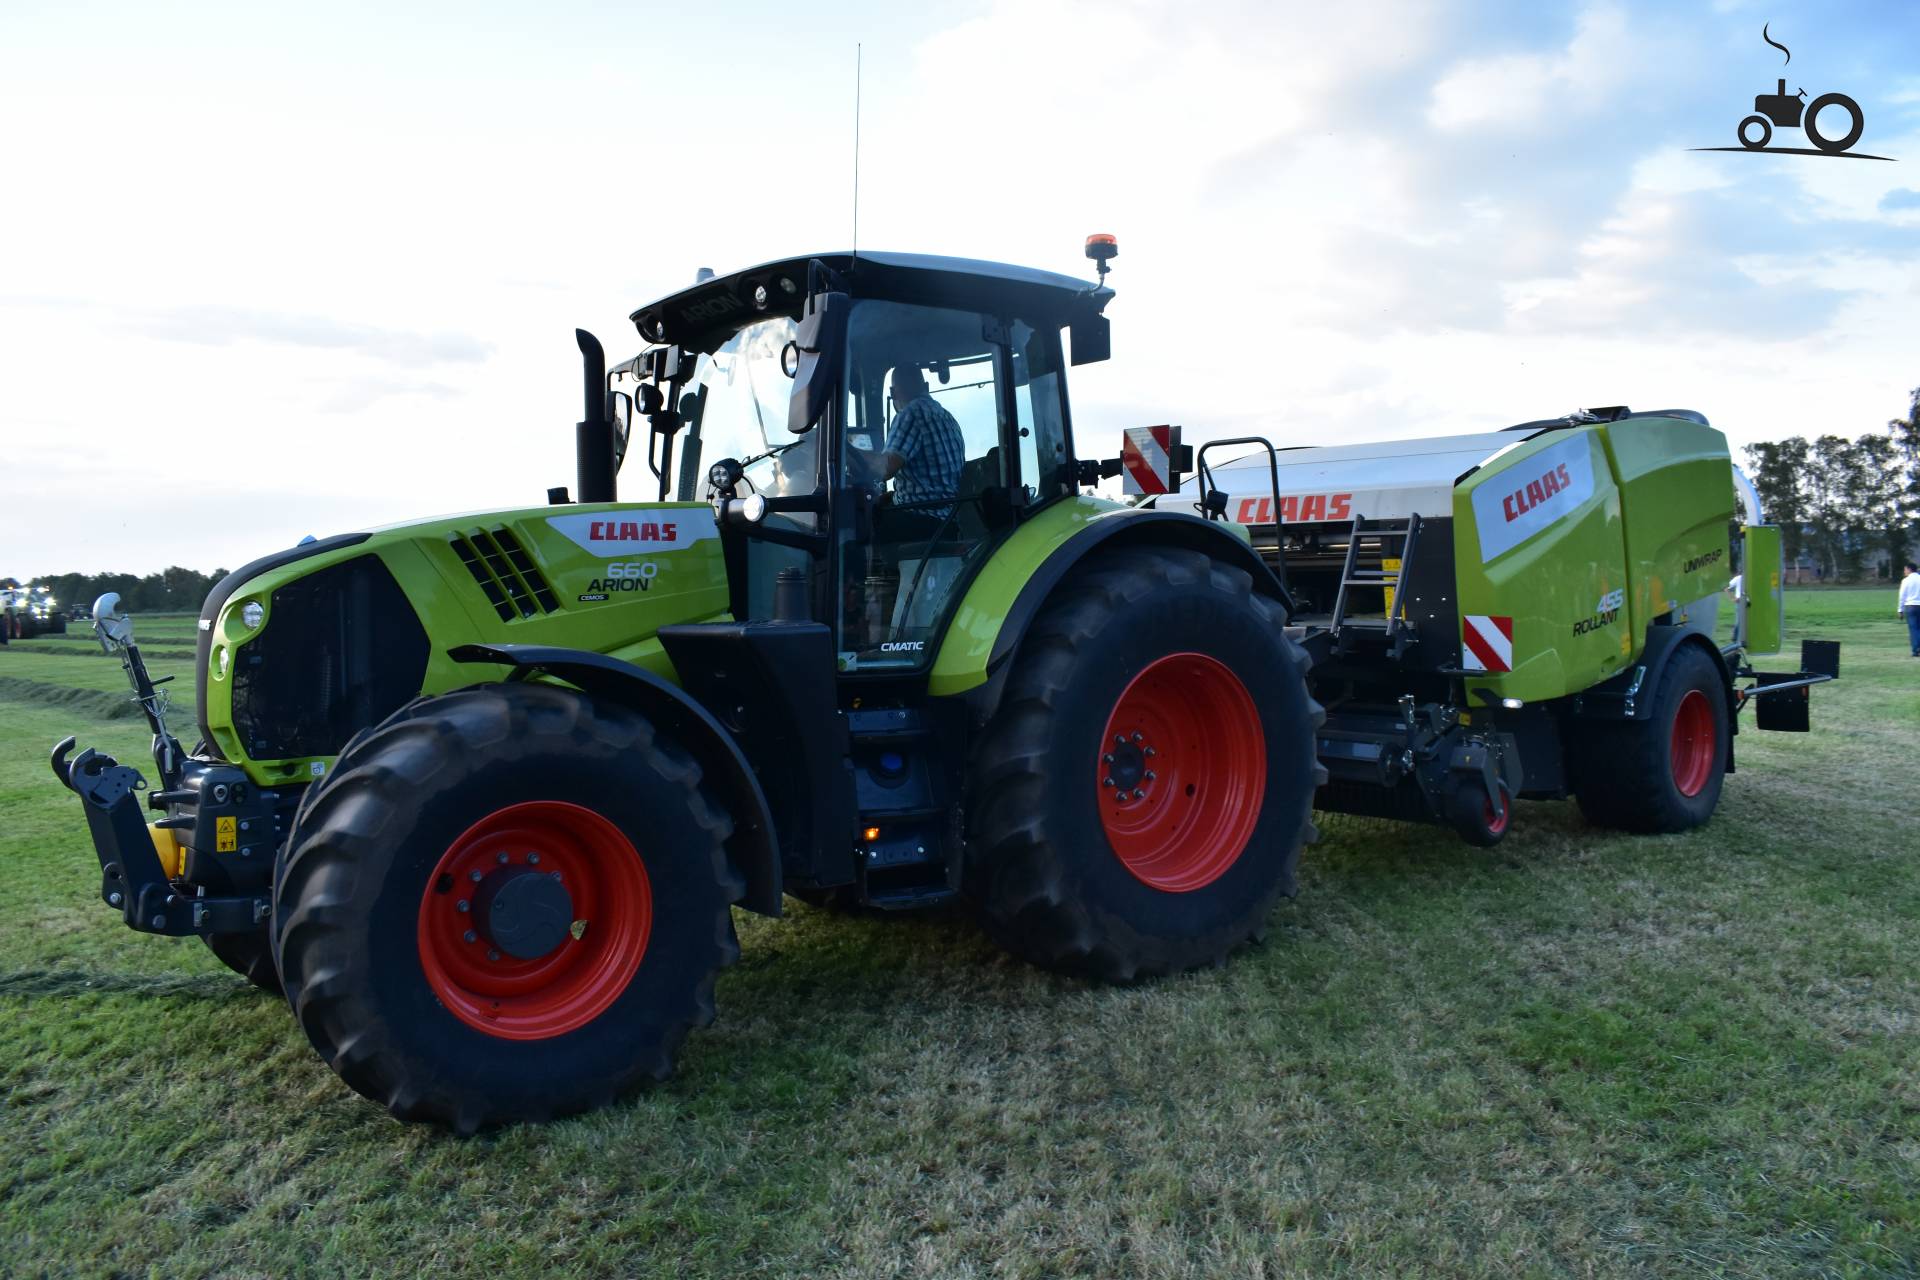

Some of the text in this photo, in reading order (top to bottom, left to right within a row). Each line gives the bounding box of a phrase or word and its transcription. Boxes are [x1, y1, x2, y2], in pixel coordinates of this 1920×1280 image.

[1503, 463, 1571, 523] CLAAS
[1237, 493, 1353, 523] CLAAS
[589, 521, 677, 541] CLAAS
[607, 562, 658, 578] 660
[587, 578, 649, 592] ARION
[1572, 607, 1620, 638] ROLLANT
[880, 641, 925, 652] CMATIC
